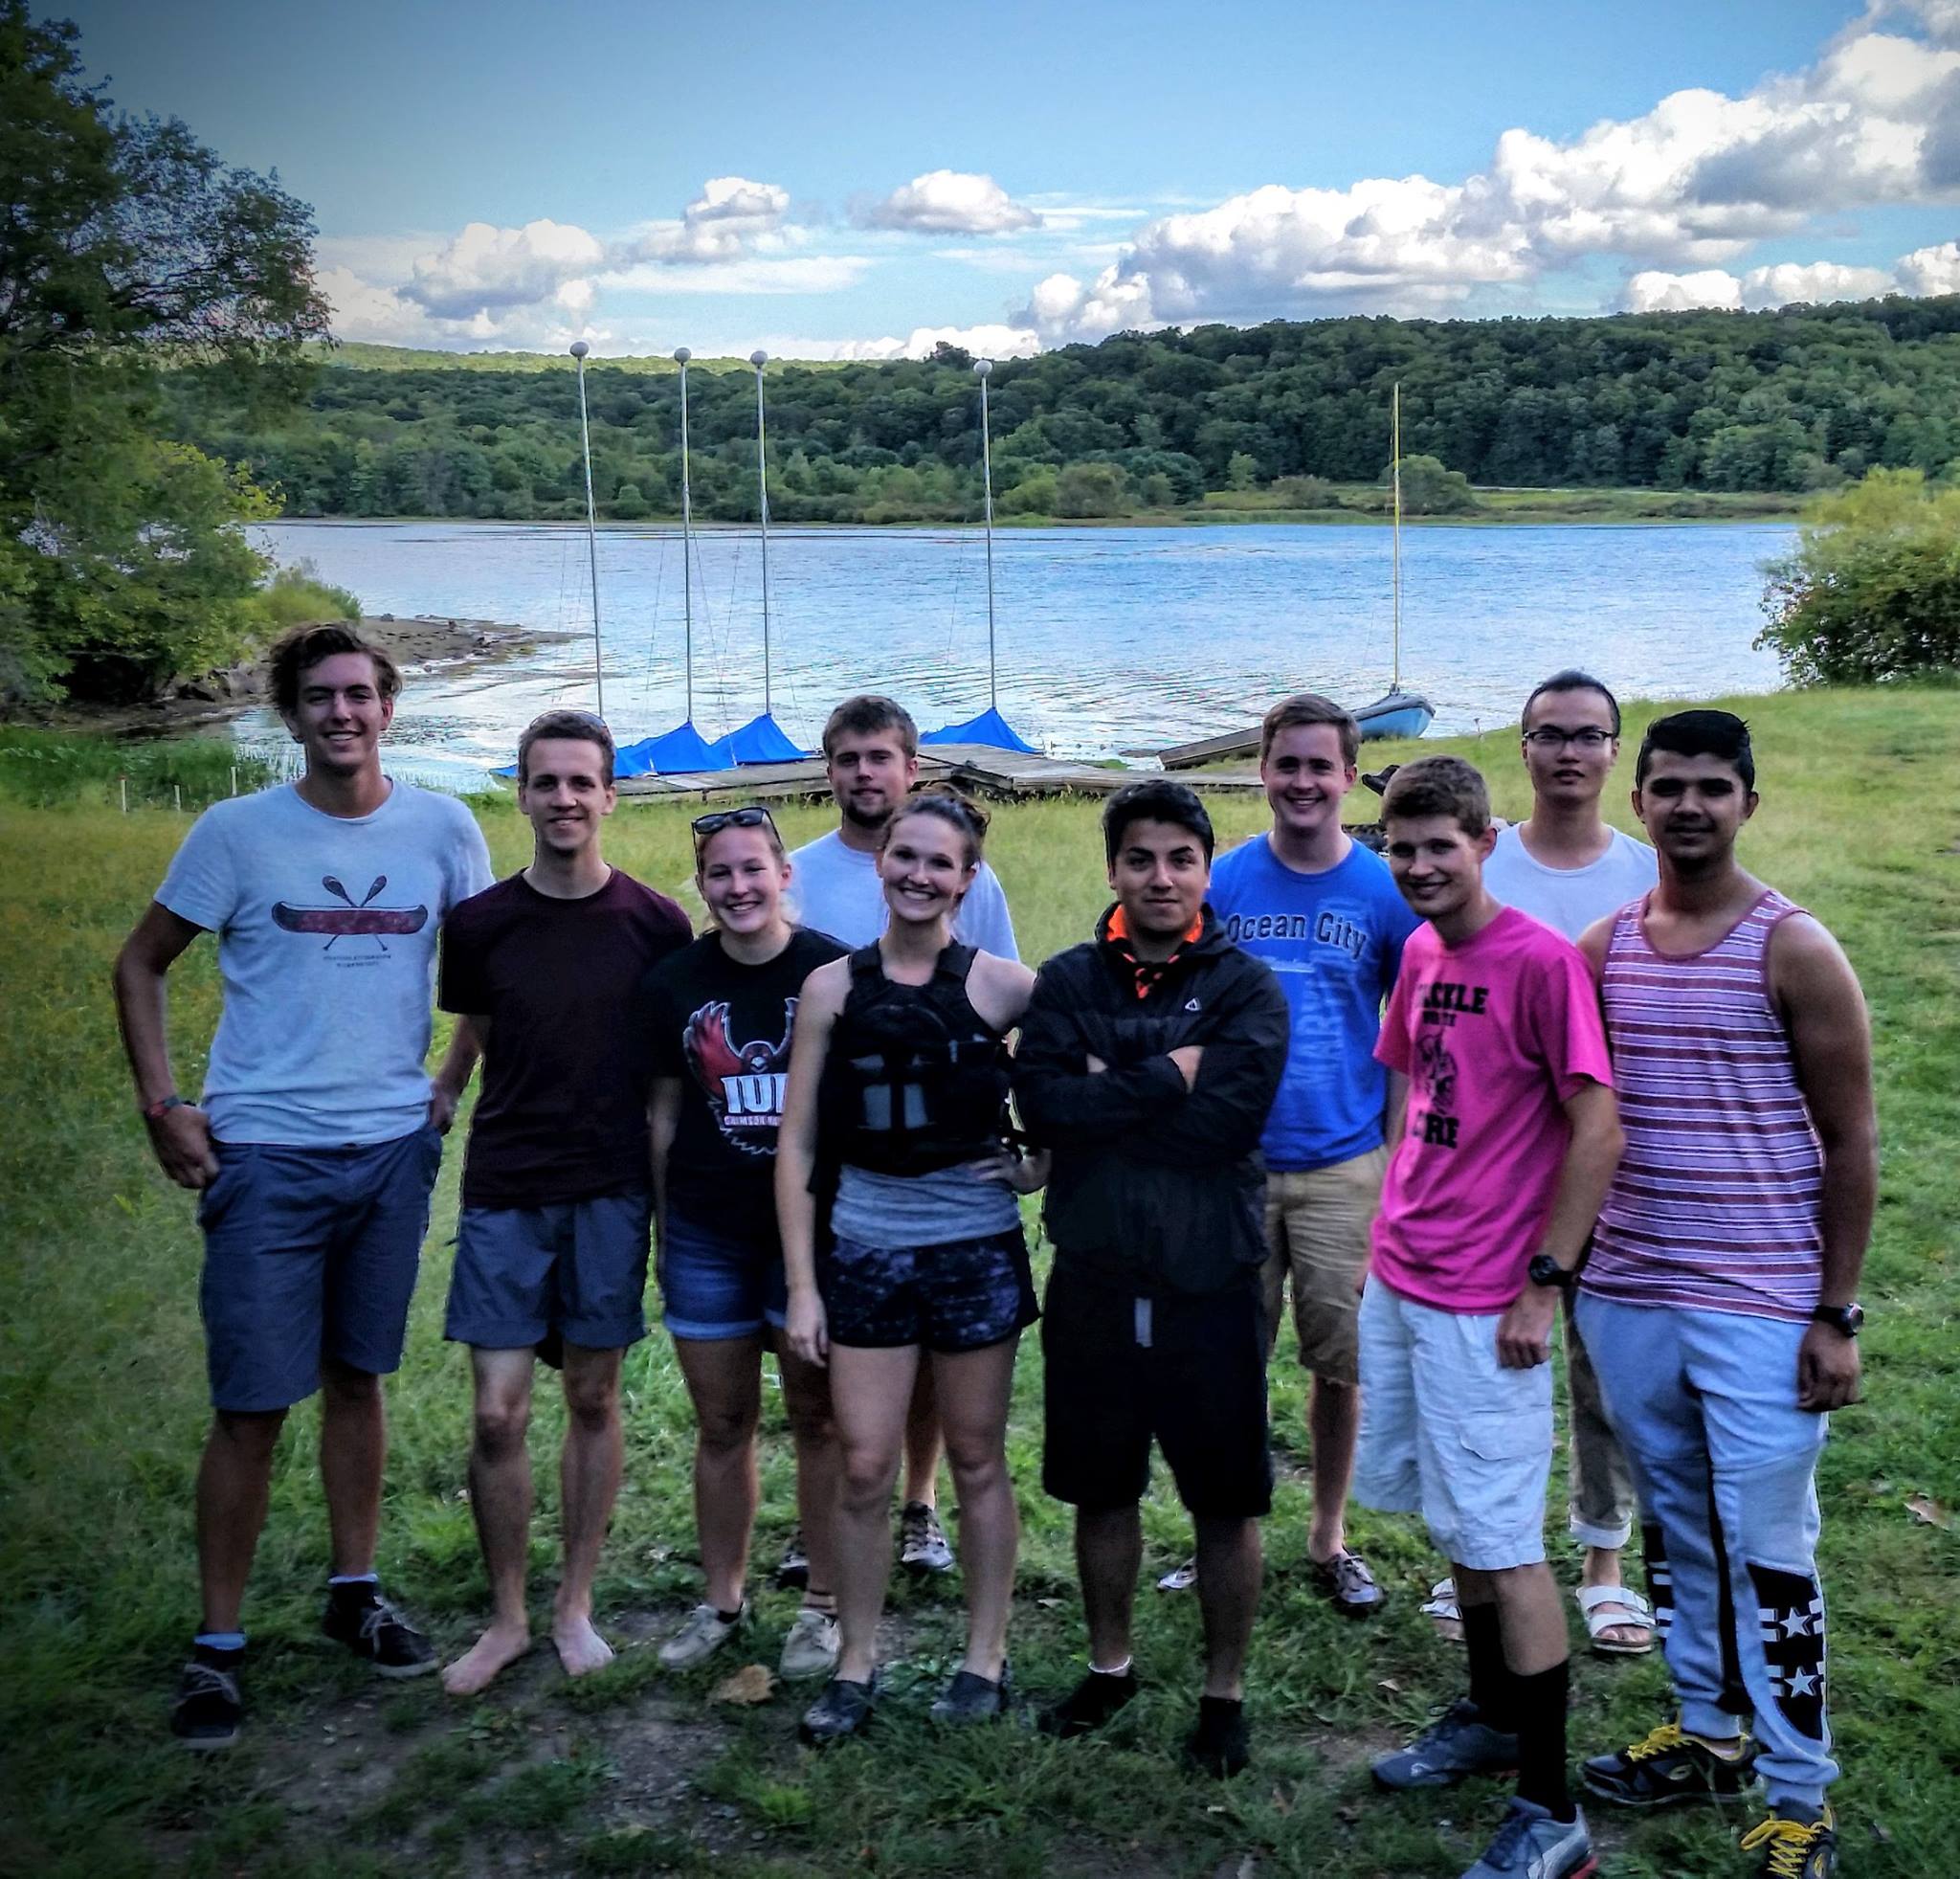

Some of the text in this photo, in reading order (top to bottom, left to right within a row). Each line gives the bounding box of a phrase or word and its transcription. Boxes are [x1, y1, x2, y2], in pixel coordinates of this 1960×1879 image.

[1227, 911, 1368, 961] Ocean City
[1285, 896, 1367, 1091] MARYLAD
